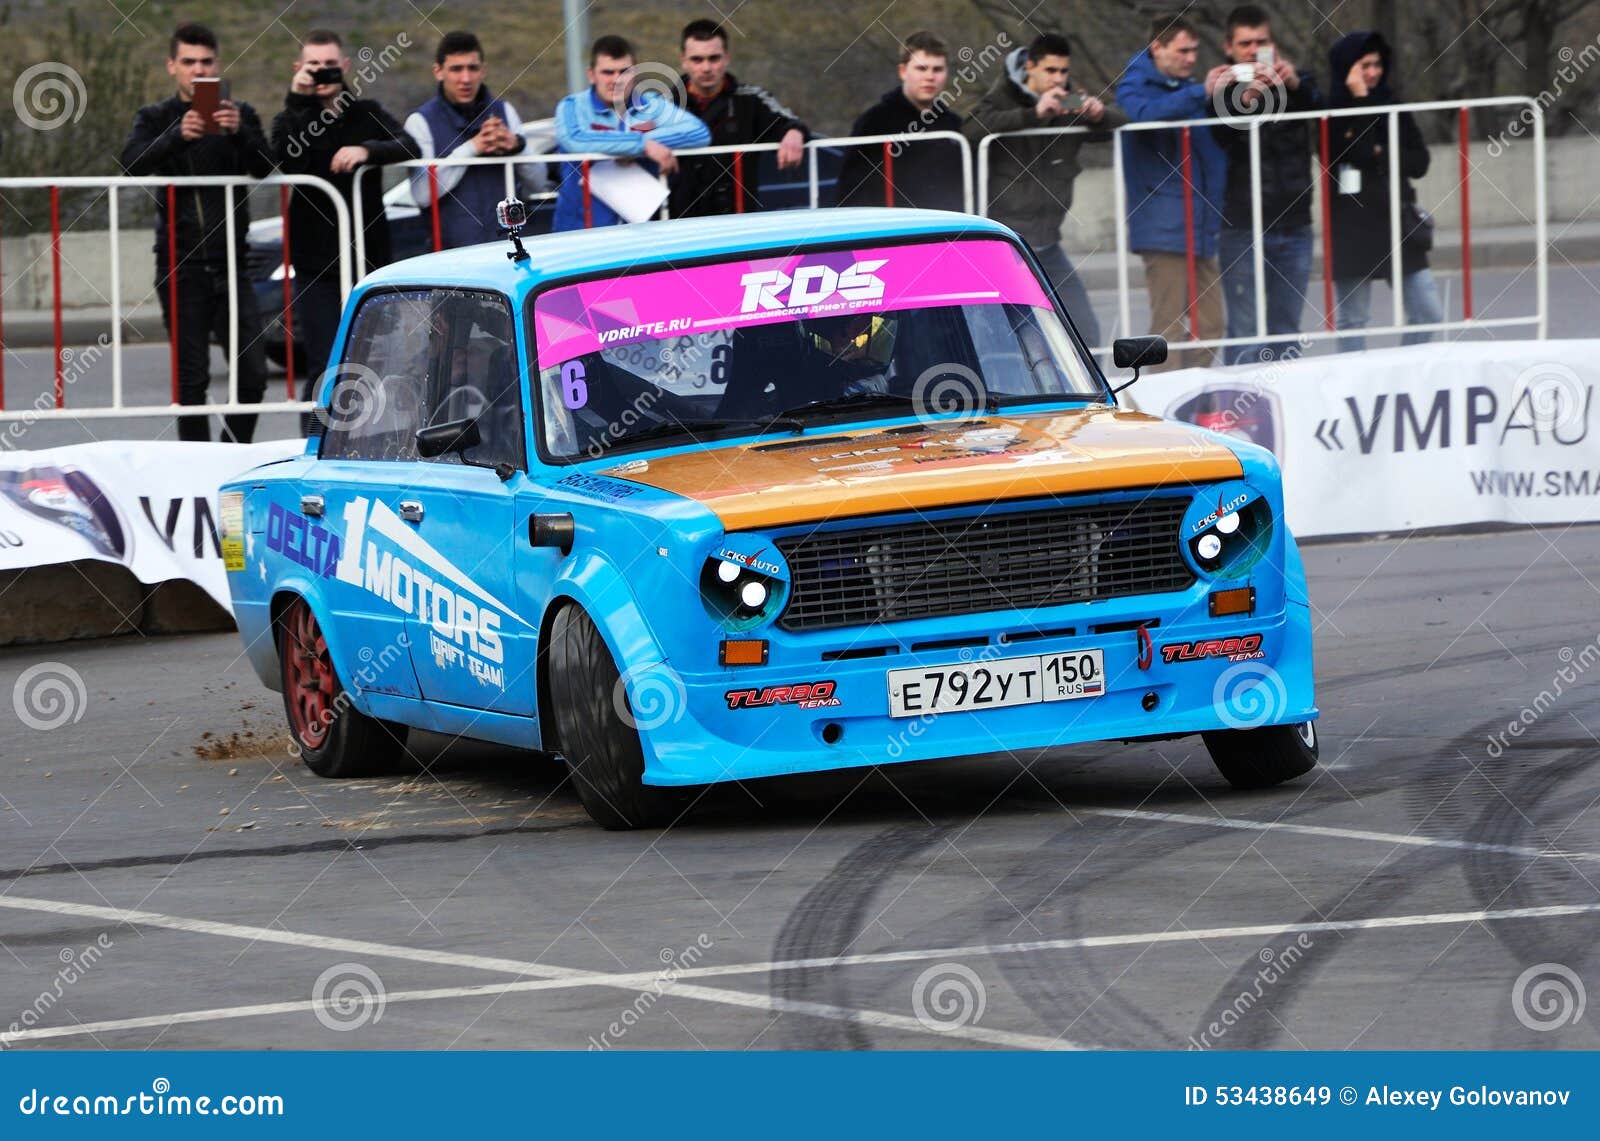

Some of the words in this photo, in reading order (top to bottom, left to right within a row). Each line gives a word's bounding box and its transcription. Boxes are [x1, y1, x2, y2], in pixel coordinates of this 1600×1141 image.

[740, 259, 890, 313] RDS
[810, 302, 846, 314] ДРИФТ
[848, 299, 883, 310] СЕРИЯ
[597, 317, 692, 344] VDRIFTE.RU
[561, 360, 588, 410] 6
[751, 559, 780, 574] AUTO
[267, 502, 341, 579] DELTA
[365, 541, 504, 664] MOTORS
[1162, 635, 1262, 662] TURBO
[1229, 651, 1266, 662] TEMA
[1046, 653, 1096, 685] 150
[726, 681, 836, 708] TURBO
[799, 697, 841, 710] TEMA
[1058, 684, 1084, 696] RUS
